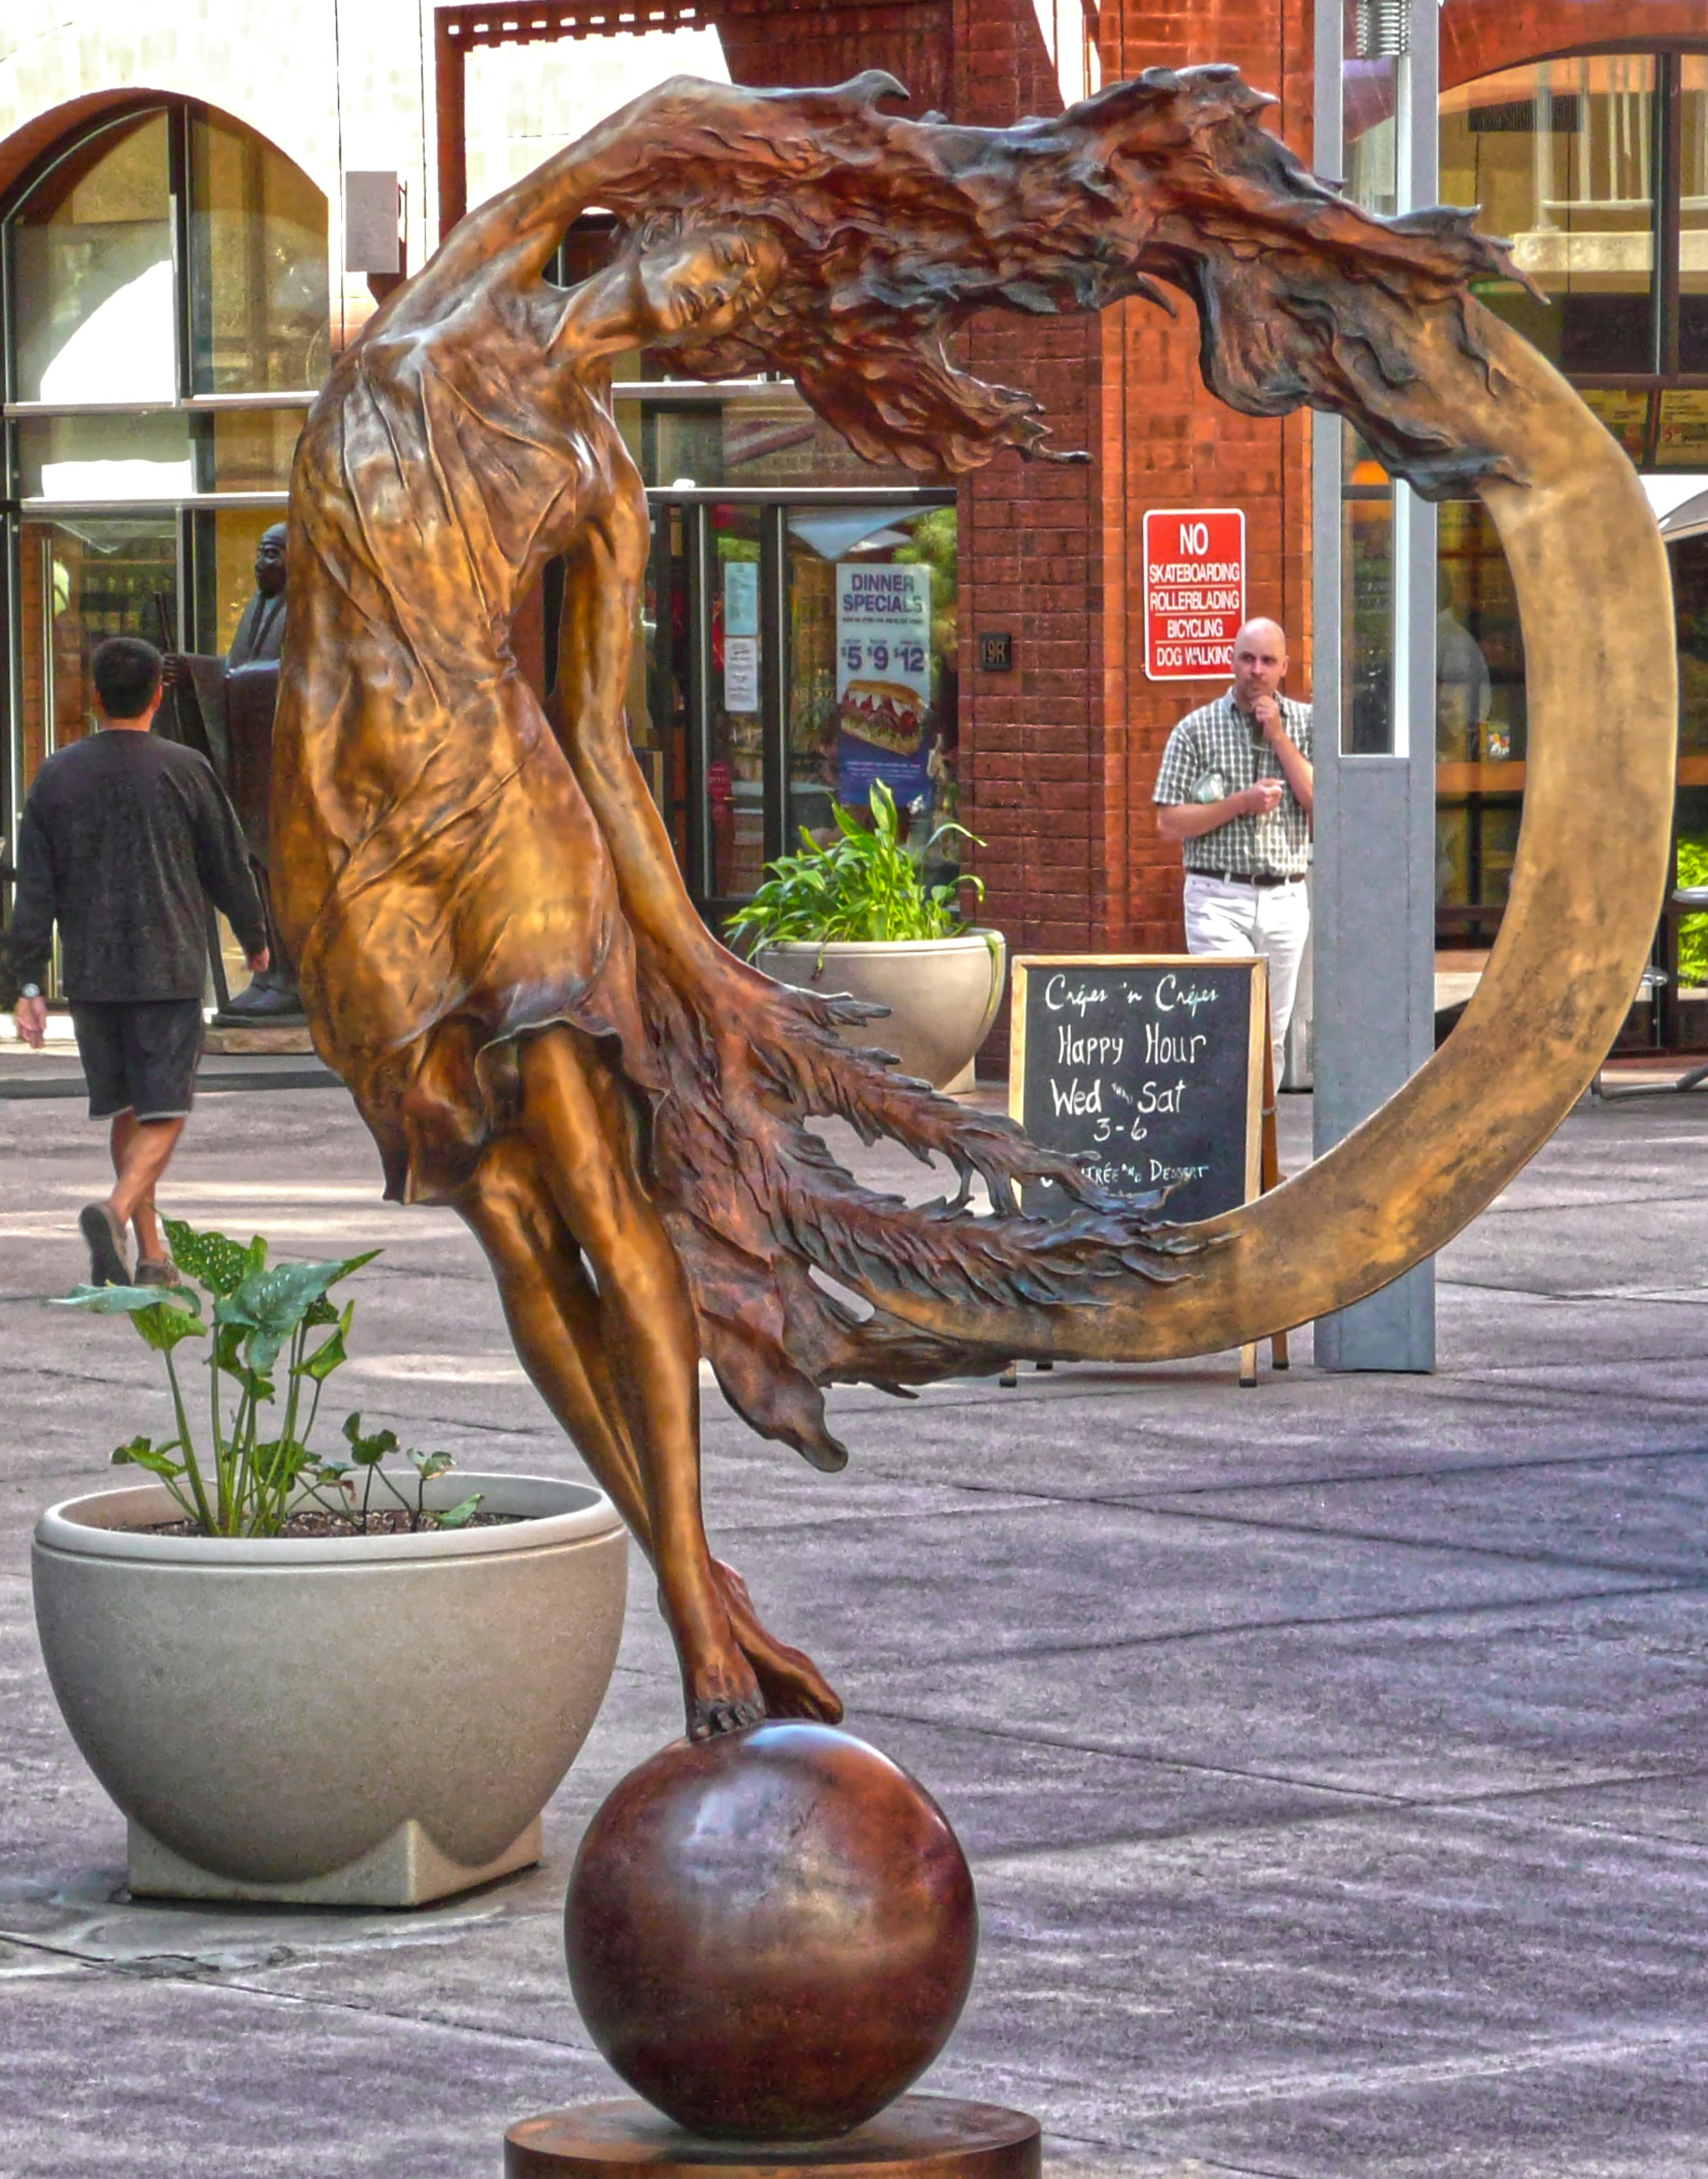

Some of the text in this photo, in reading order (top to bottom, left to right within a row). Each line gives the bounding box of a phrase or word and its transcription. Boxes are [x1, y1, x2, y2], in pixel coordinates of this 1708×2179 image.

[1179, 522, 1208, 555] NO
[852, 574, 914, 591] DINNER
[1149, 563, 1239, 583] SKATEBOARDING
[843, 594, 923, 613] SPECIALS
[1150, 591, 1239, 610] ROLLERBLADING
[1168, 619, 1223, 638] BICYCLING
[1156, 647, 1182, 666] DOG
[1058, 1023, 1206, 1066] Happy Hour
[1051, 1078, 1101, 1118] Wed
[1137, 1079, 1186, 1113] Sat
